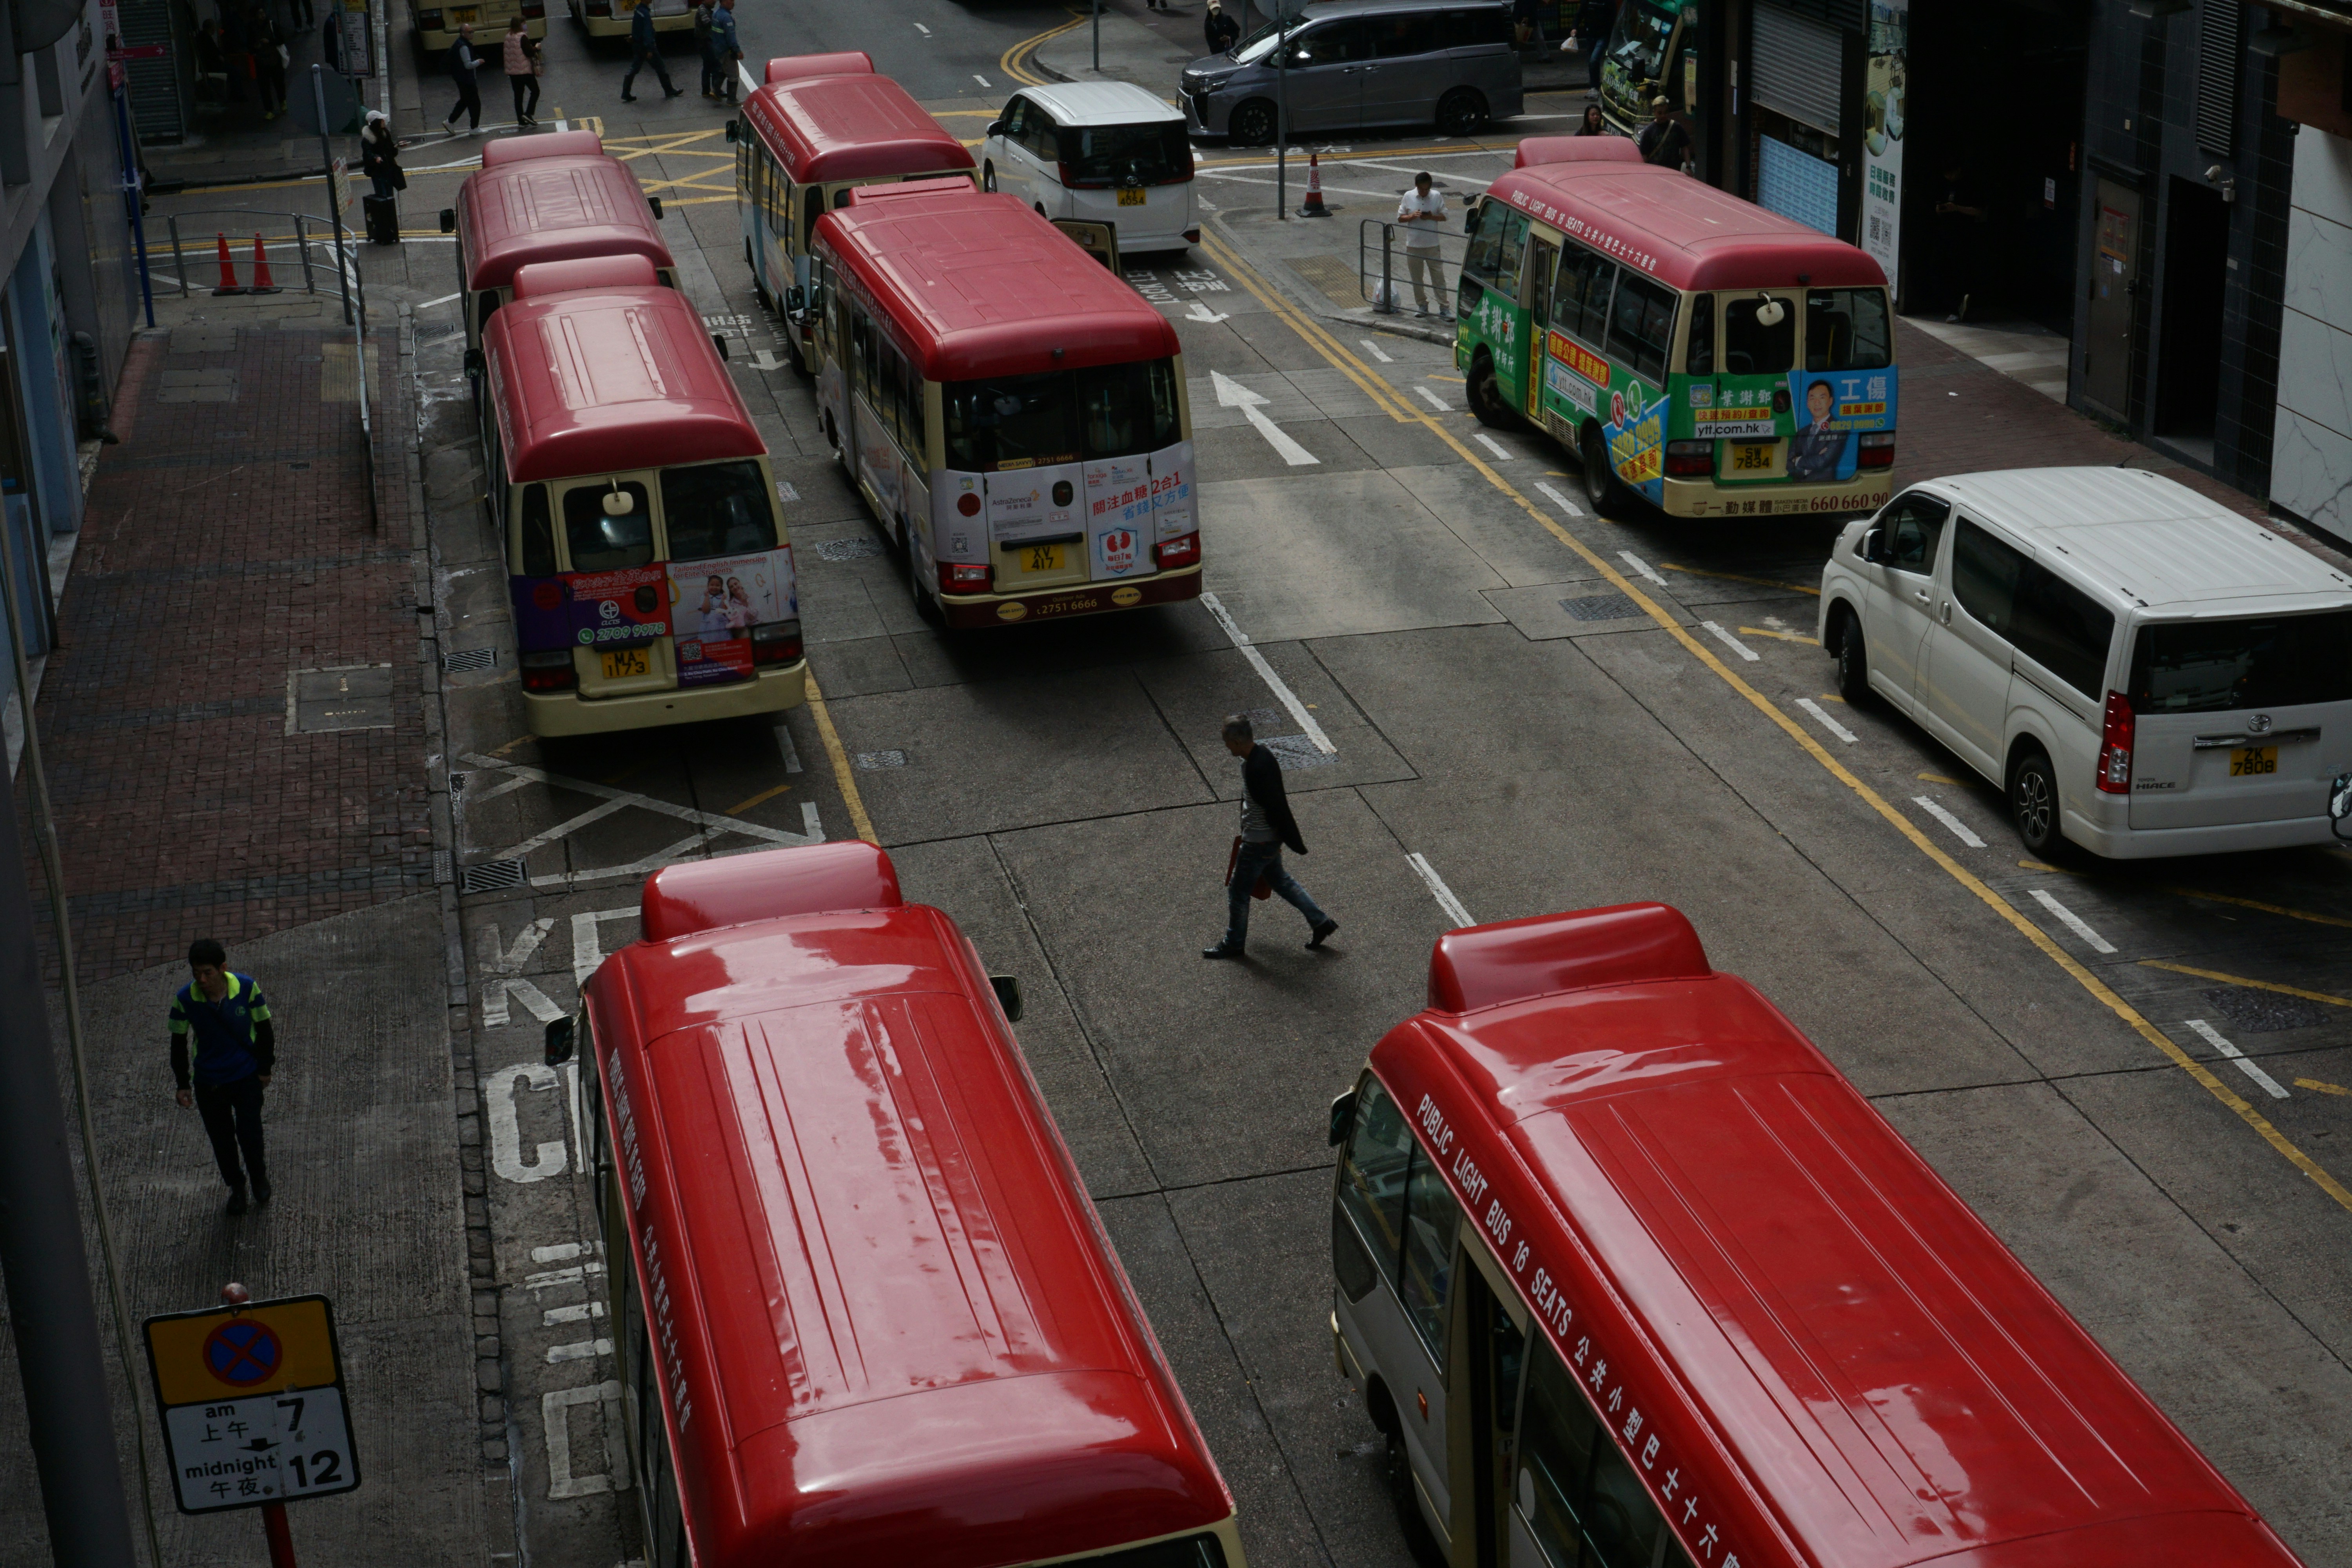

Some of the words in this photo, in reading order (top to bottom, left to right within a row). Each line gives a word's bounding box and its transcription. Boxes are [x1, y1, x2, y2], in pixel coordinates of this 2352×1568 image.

[1120, 196, 1145, 205] 4054
[1511, 189, 1529, 207] PUBLIC
[1528, 198, 1545, 214] LIGHT
[1544, 206, 1557, 221] BUS
[1557, 212, 1564, 224] 16
[1565, 216, 1584, 234] SEATS
[1559, 375, 1592, 407] ytt.com.hk
[1839, 375, 1887, 401] 工傷
[1698, 423, 1760, 437] ytt.com.hk
[1056, 454, 1073, 463] 6666
[1745, 447, 1762, 458] SW
[1736, 457, 1770, 469] 7834
[992, 496, 1032, 506] AstraZeneca
[1093, 485, 1148, 516] 關注血糖
[1151, 471, 1181, 495] 2合1
[1122, 483, 1189, 521] 省錢又方便
[1811, 495, 1838, 511] 660
[1841, 494, 1869, 510] 660
[1872, 492, 1889, 508] 90
[1033, 546, 1051, 559] XV
[674, 564, 702, 573] Tailored
[703, 561, 728, 570] English
[730, 556, 767, 566] Immersion
[701, 567, 732, 576] Students
[1031, 557, 1054, 570] 417
[1042, 603, 1067, 615] 2751
[1070, 598, 1098, 610] 6666
[597, 625, 632, 641] 2709
[632, 622, 666, 638] 9978
[614, 651, 637, 664] MA
[608, 661, 646, 677] 1173
[2244, 747, 2264, 762] ZK
[2234, 760, 2275, 776] 7808
[608, 1047, 624, 1098] PUBLIC
[615, 1085, 630, 1131] LIGHT
[623, 1116, 636, 1156] BUS
[628, 1143, 639, 1171] 16
[631, 1158, 646, 1211] SEATS
[1416, 1093, 1454, 1155] PUBLIC
[1452, 1147, 1488, 1206] LIGHT
[1485, 1198, 1512, 1246] BUS
[1512, 1239, 1530, 1273] 16
[1531, 1267, 1573, 1337] SEATS
[205, 1404, 236, 1419] am
[277, 1397, 305, 1432] 7
[200, 1420, 249, 1443] 上午
[185, 1453, 277, 1478] midnight
[289, 1448, 342, 1487] 12
[210, 1477, 260, 1499] 午夜
